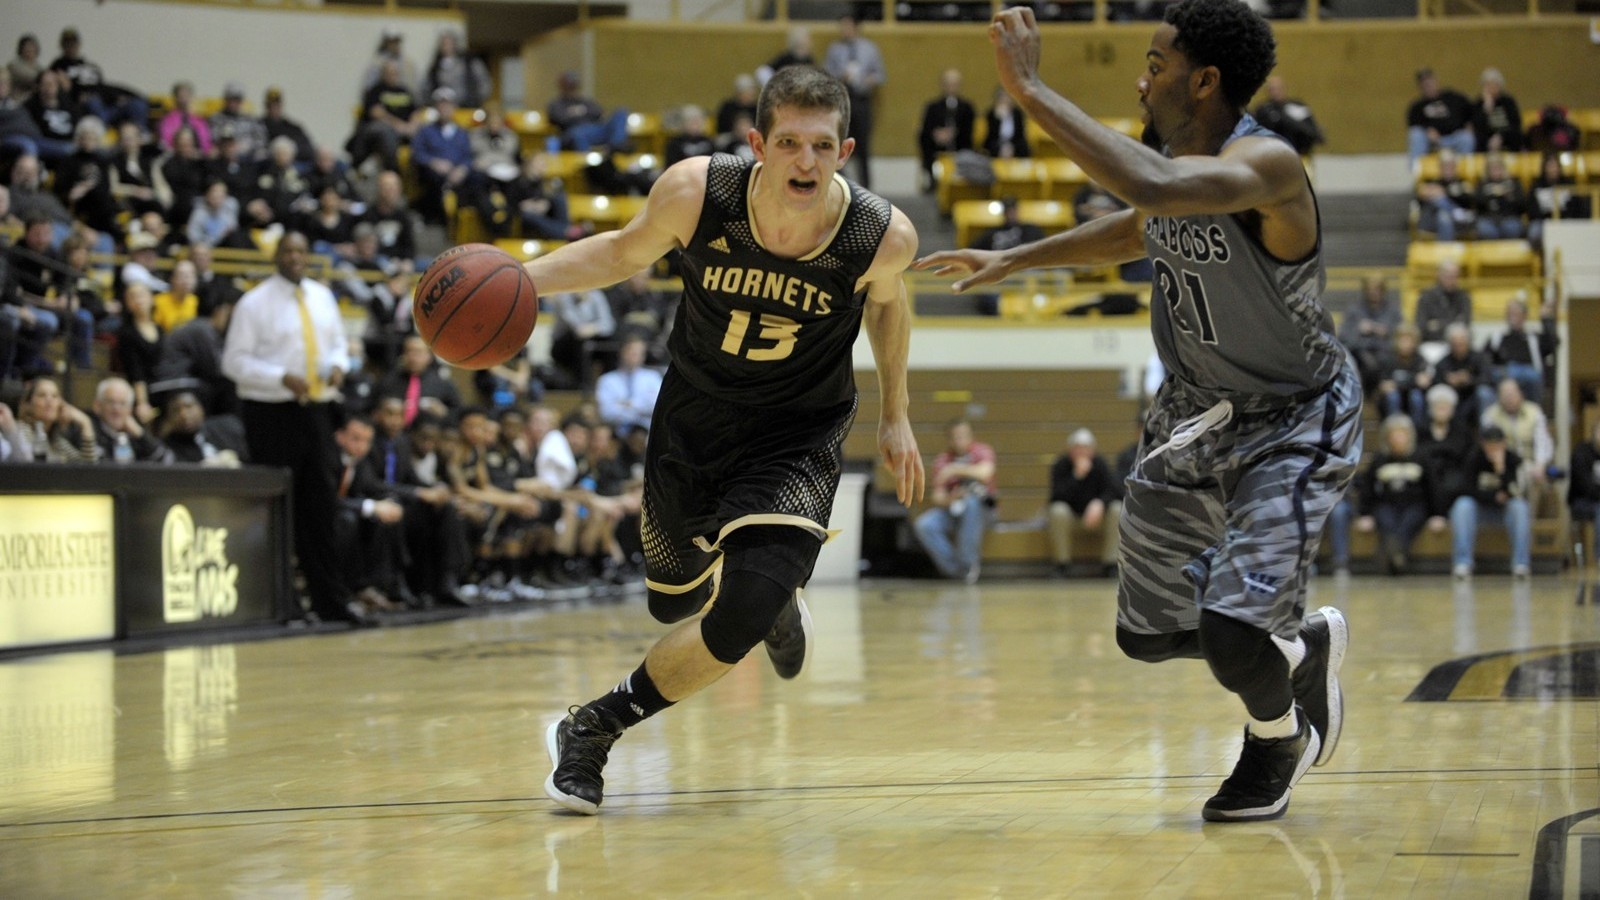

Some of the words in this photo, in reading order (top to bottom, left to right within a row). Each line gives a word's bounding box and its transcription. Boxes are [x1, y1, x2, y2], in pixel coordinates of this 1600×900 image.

[421, 265, 466, 318] NCAA
[702, 266, 832, 315] HORNETS
[1153, 257, 1218, 345] 21
[721, 309, 802, 361] 13
[0, 571, 109, 600] NIVERSITY
